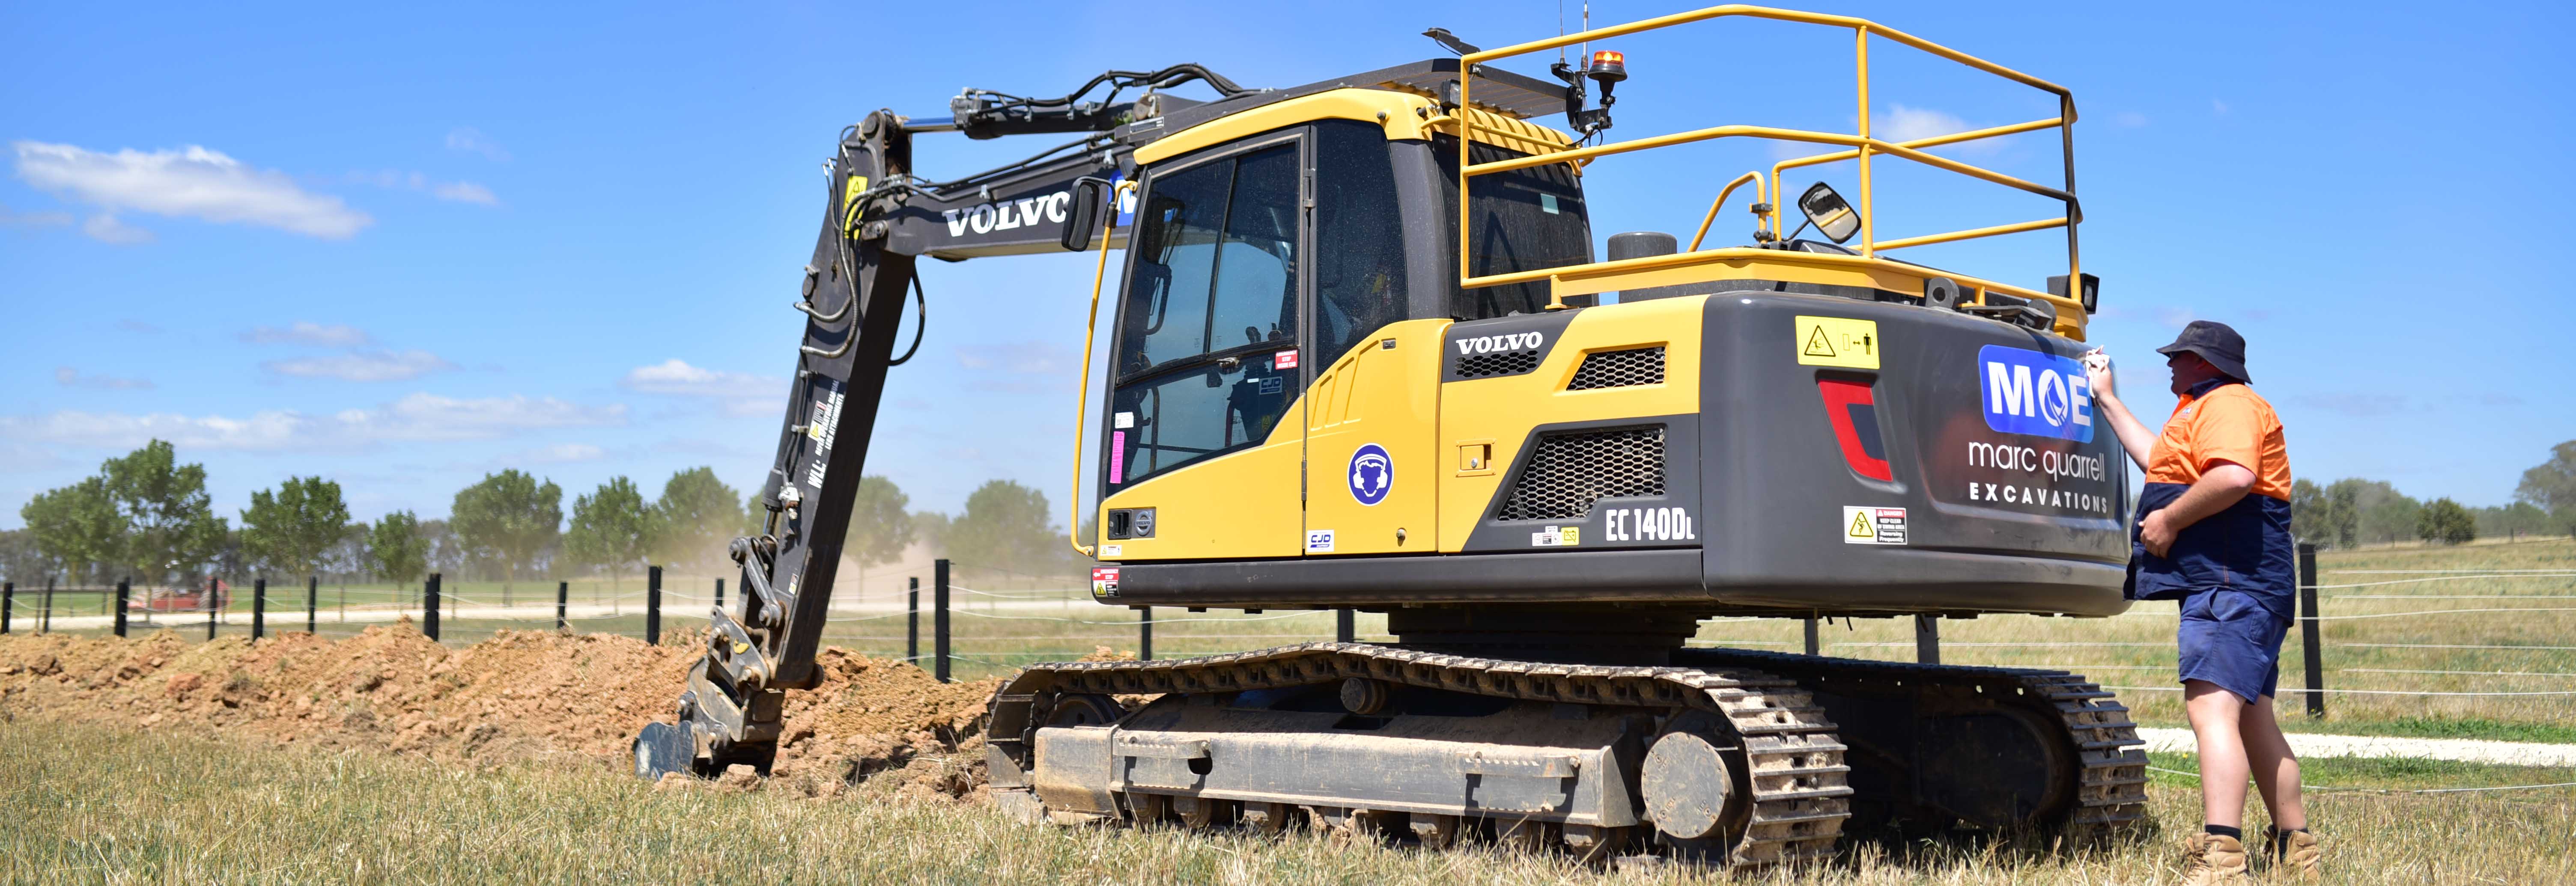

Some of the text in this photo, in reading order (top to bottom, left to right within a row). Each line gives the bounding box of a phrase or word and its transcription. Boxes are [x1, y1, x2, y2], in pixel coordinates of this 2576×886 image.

[942, 191, 1070, 237] VOLVO
[1456, 331, 1543, 354] VOLVO
[1261, 378, 1281, 388] CJD
[824, 392, 844, 450] LESS ATTACHMENTS
[808, 459, 826, 488] WLL:
[1969, 442, 2105, 482] marc quarrell
[1970, 482, 2107, 513] EXCAVATIONS
[1311, 535, 1330, 543] CJD
